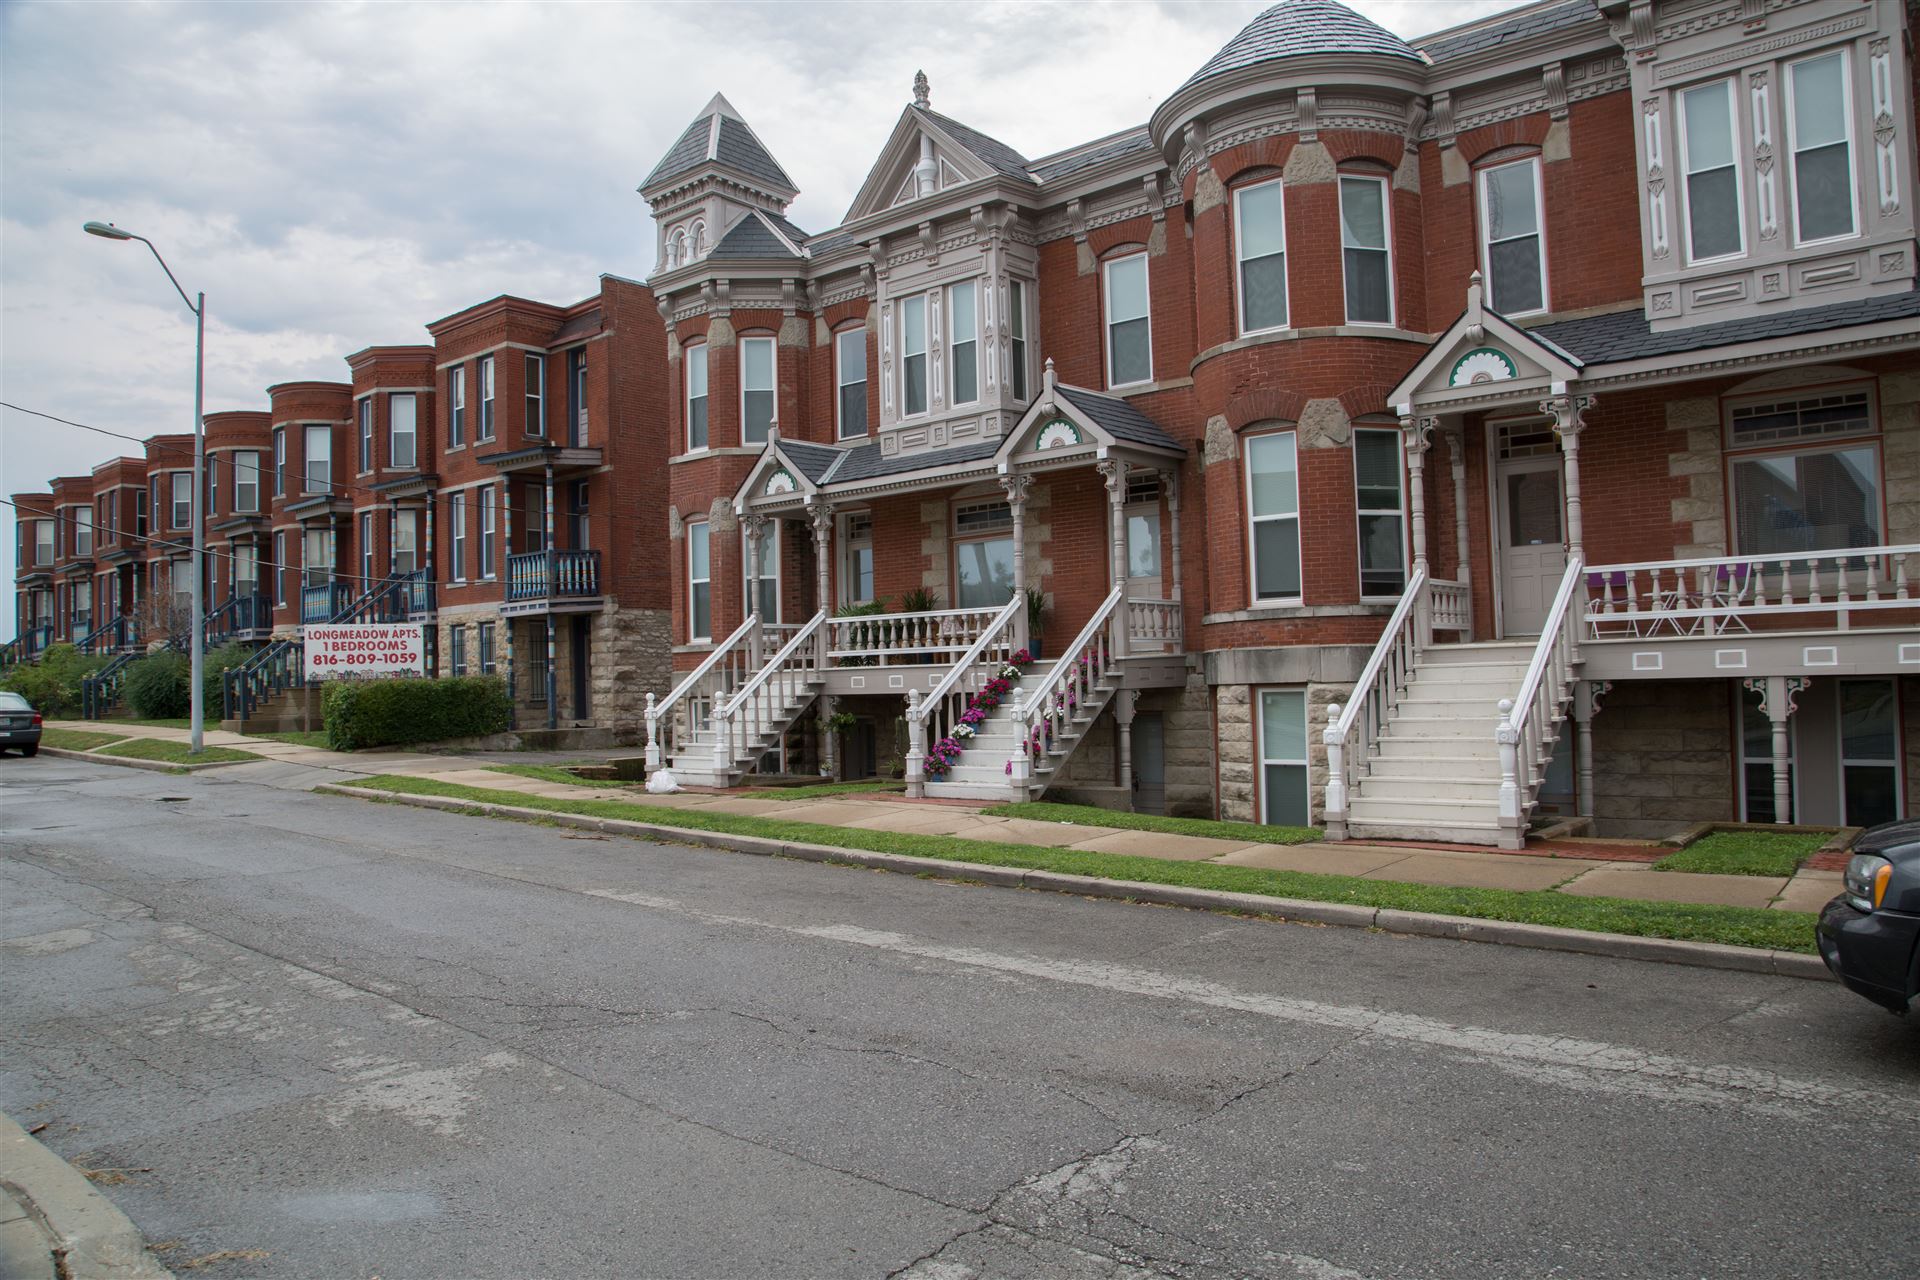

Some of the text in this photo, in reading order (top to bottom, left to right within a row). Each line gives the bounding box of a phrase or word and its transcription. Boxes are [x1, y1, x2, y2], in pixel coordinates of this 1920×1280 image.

[308, 629, 420, 640] LONGMEADOW APTS.
[323, 640, 408, 651] 1 BEDROOMS
[313, 652, 417, 665] 816-809-1059
